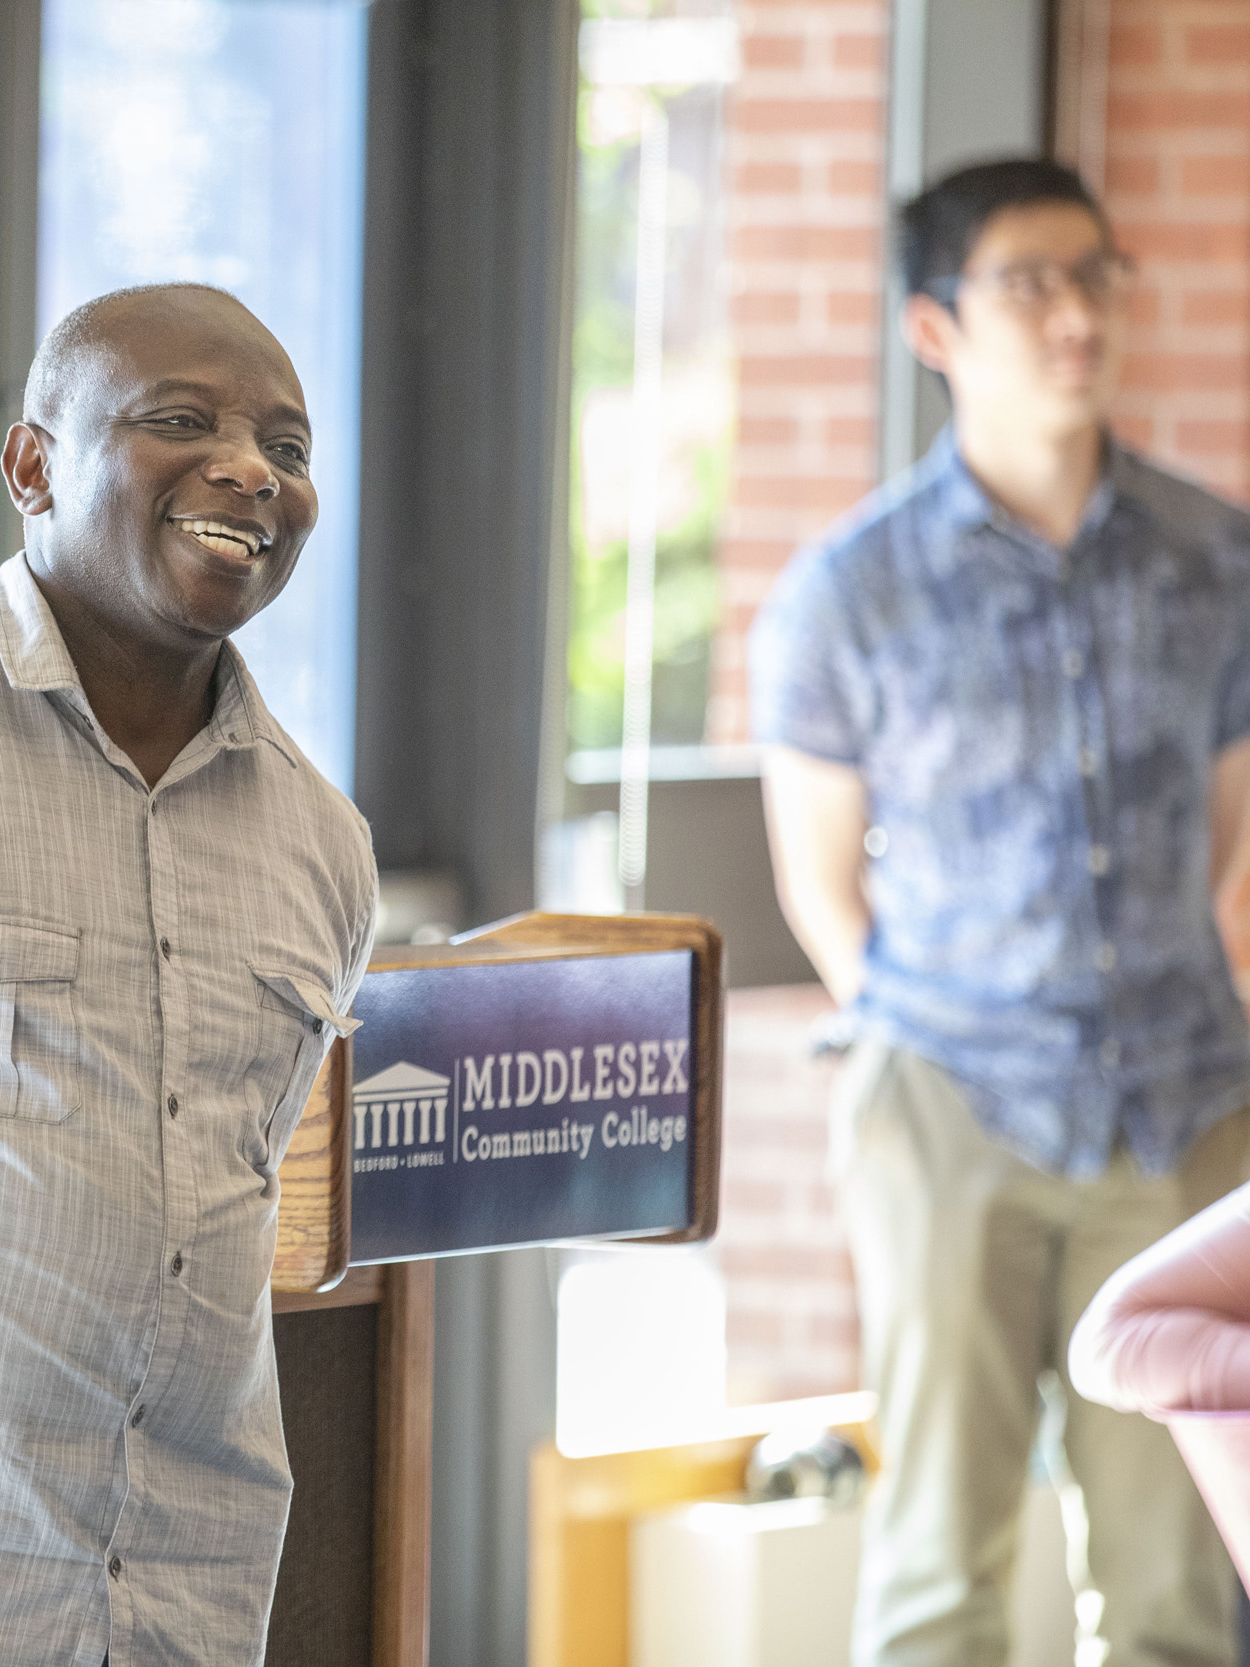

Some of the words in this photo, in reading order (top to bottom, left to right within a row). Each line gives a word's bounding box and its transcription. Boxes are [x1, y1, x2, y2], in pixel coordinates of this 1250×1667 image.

[462, 1039, 689, 1112] MIDDLESEX
[461, 1118, 595, 1161] Community
[601, 1105, 687, 1151] College
[353, 1154, 398, 1173] BEDFORD
[406, 1151, 445, 1168] LOWELL
